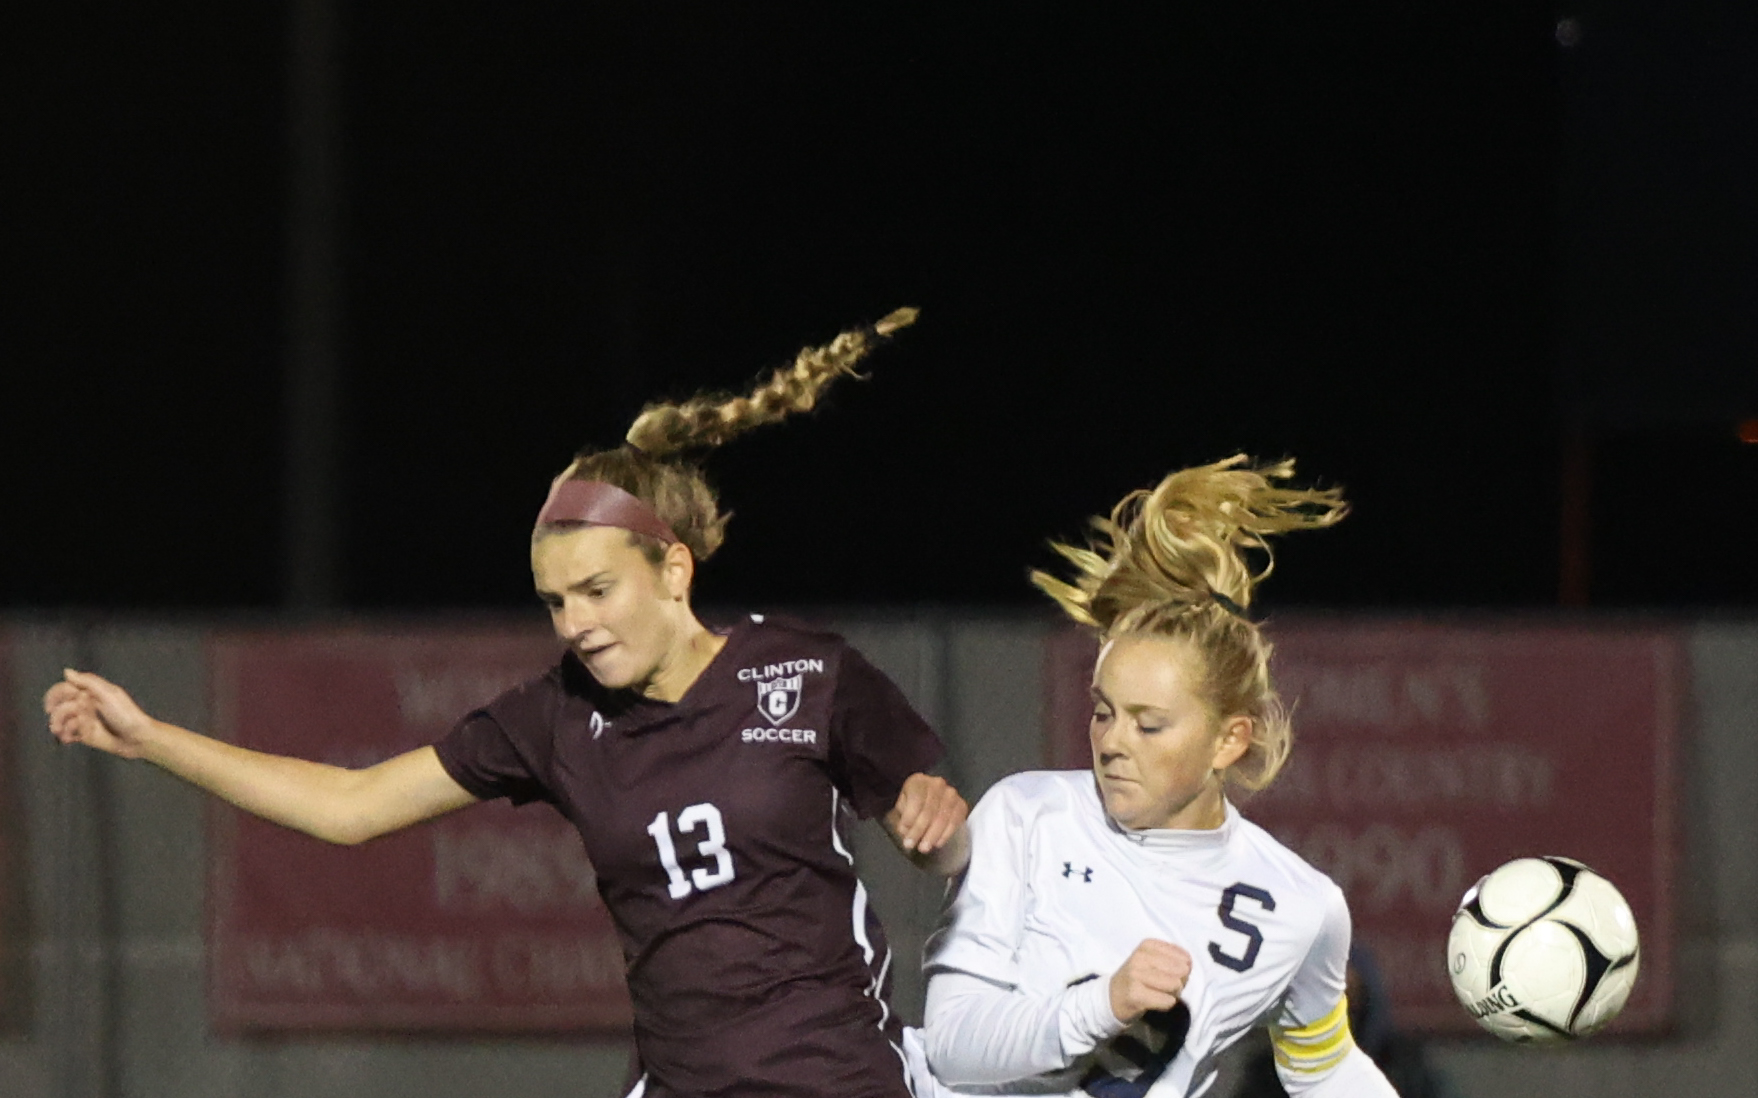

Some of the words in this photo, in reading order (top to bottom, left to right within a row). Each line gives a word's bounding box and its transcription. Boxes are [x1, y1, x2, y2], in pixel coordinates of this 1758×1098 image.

[737, 659, 824, 681] CLINTON
[768, 690, 788, 717] C
[741, 727, 817, 744] SOCCER
[646, 802, 735, 899] 13
[1207, 881, 1276, 973] S
